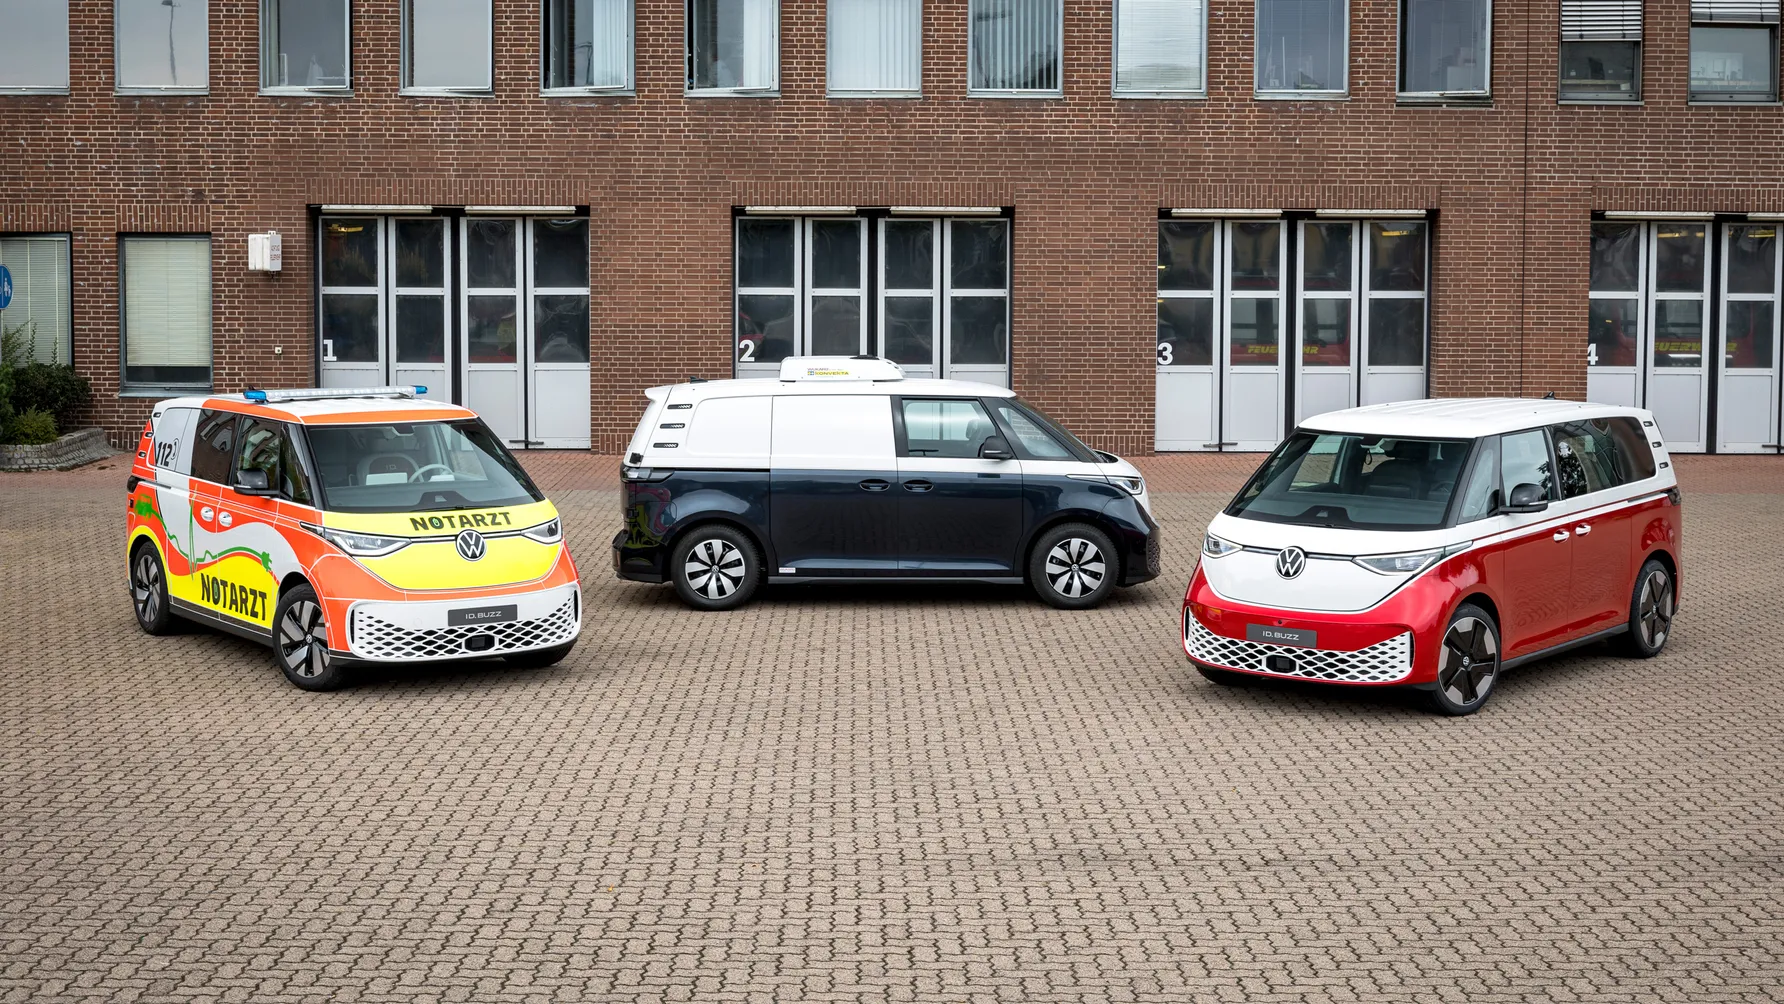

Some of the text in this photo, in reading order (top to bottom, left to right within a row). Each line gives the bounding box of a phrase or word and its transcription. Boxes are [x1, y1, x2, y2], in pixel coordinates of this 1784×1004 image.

[323, 339, 337, 362] 1
[739, 339, 755, 362] 2
[1157, 342, 1173, 365] 3
[1587, 343, 1599, 366] 4
[156, 441, 173, 467] 112
[409, 512, 512, 531] NOTARZT
[200, 572, 268, 621] NOTARZT
